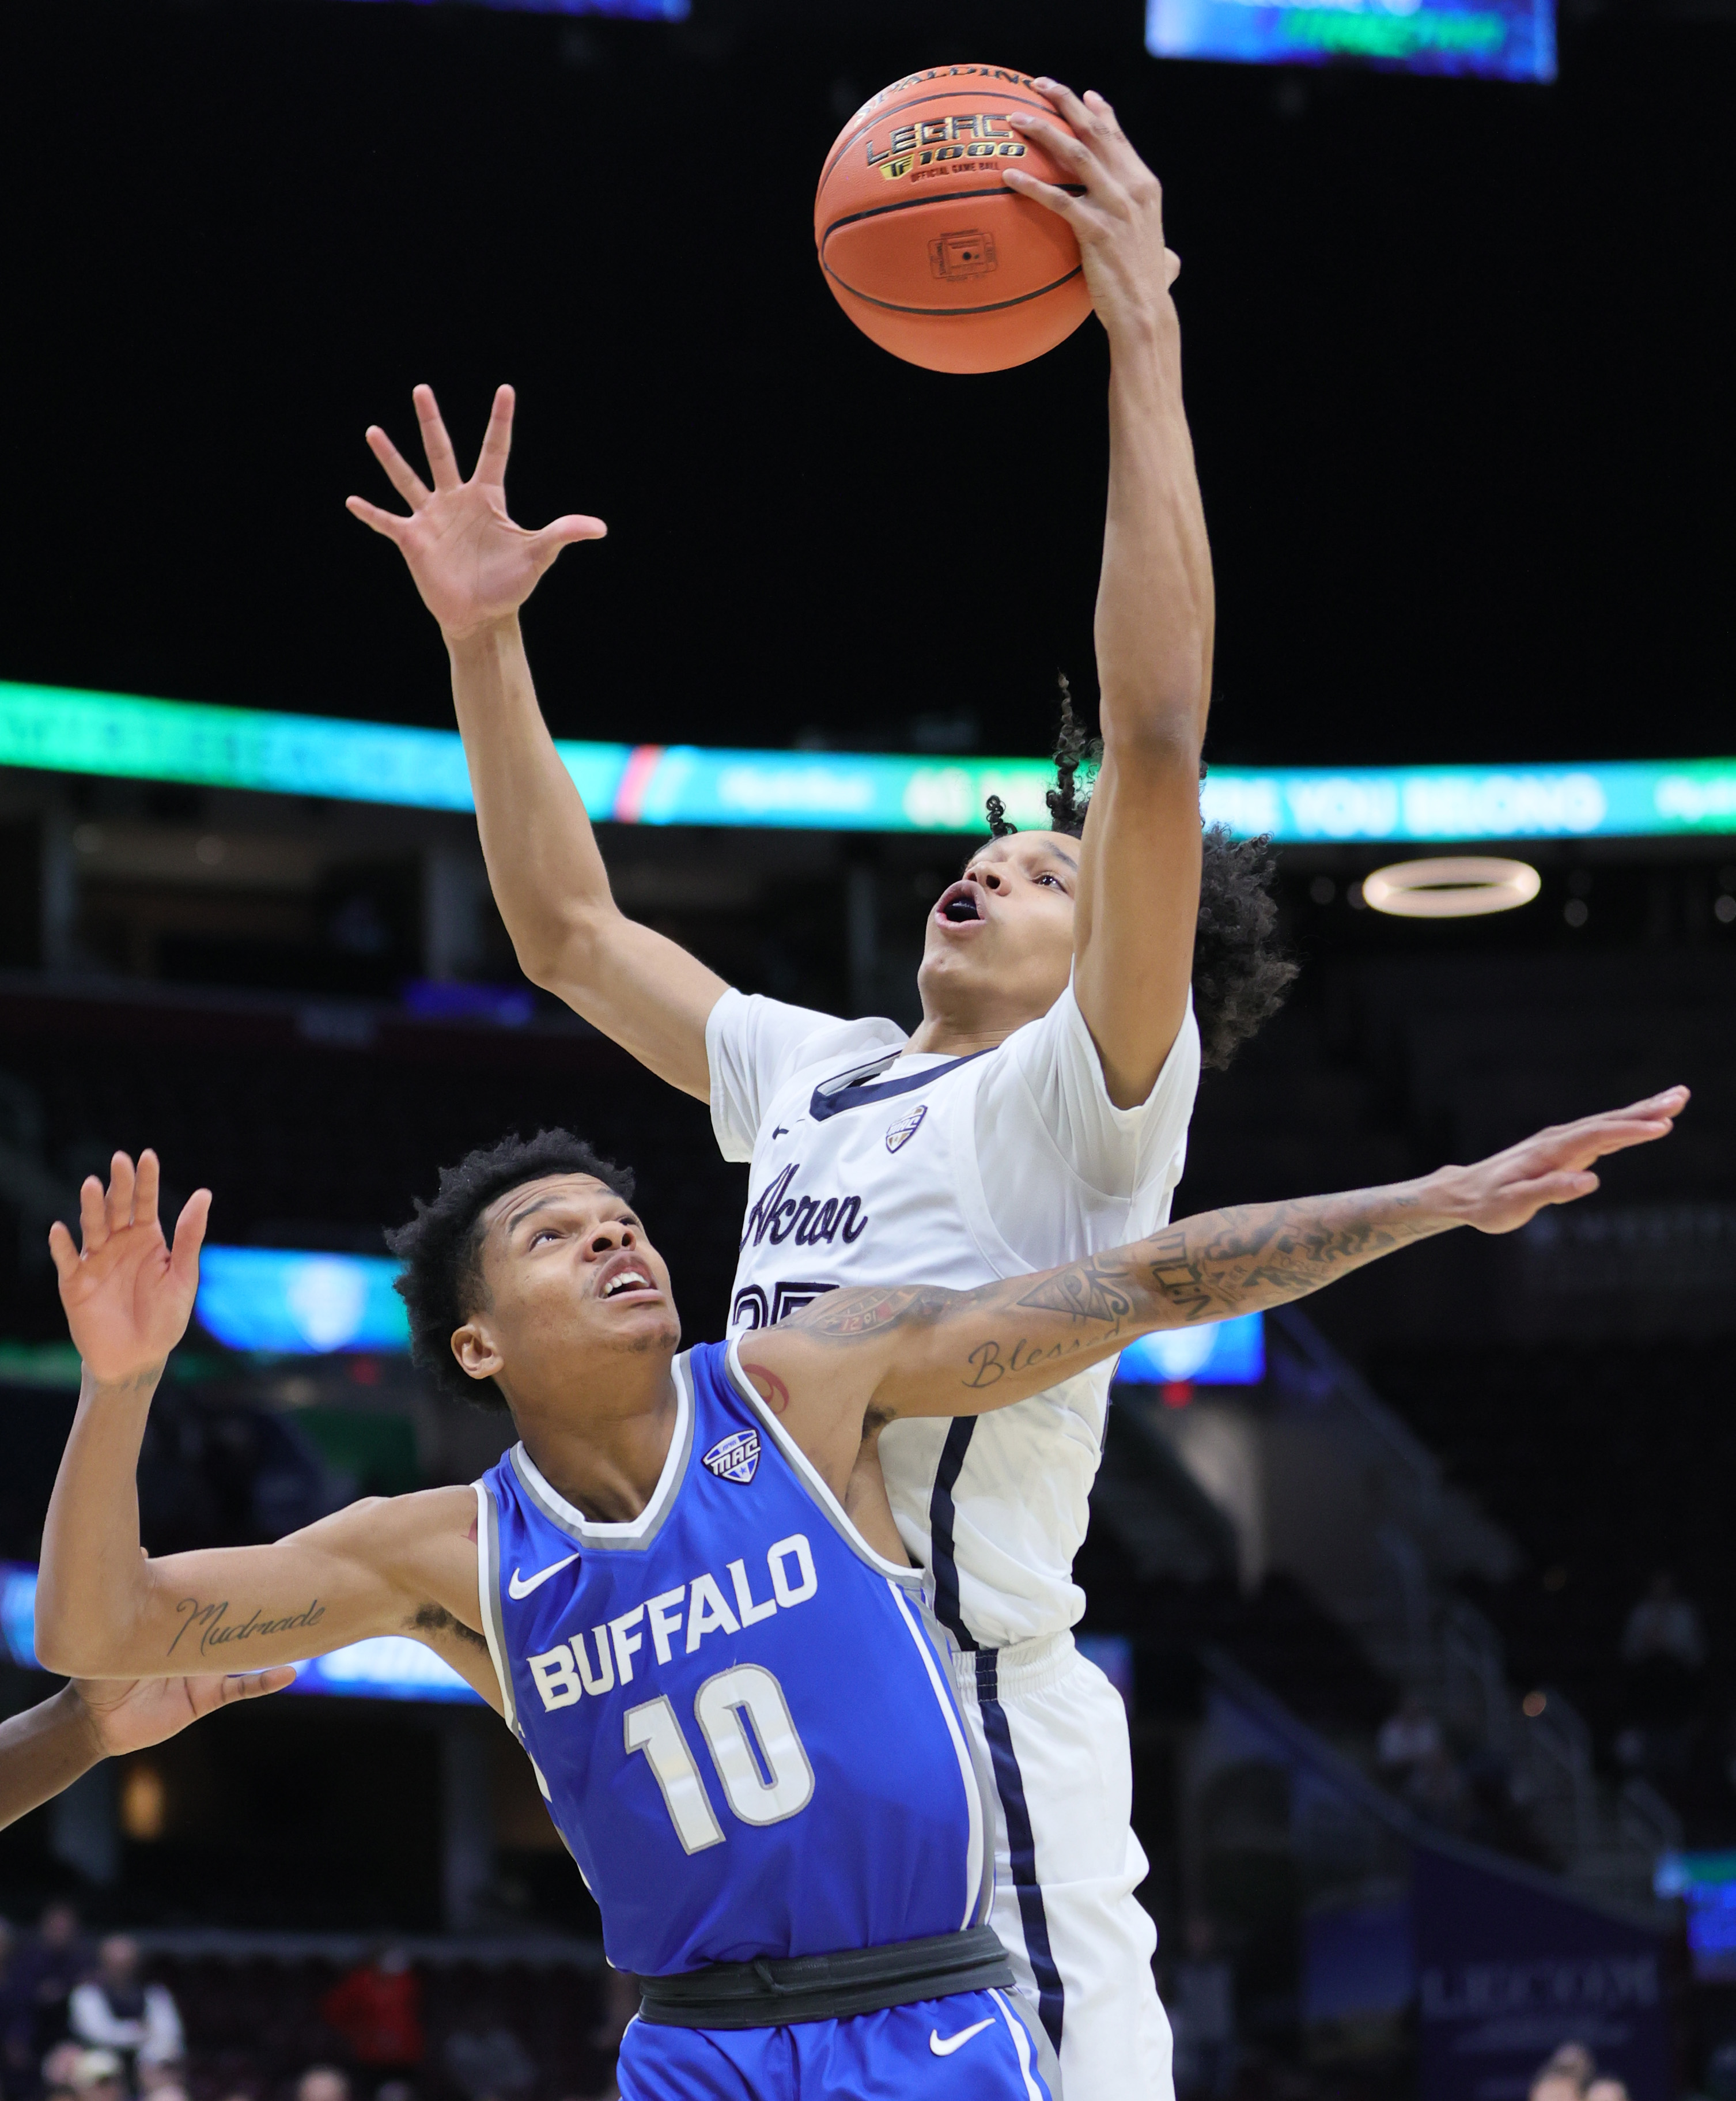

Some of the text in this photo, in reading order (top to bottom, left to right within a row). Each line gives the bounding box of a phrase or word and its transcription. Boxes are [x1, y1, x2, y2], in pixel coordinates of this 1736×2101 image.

[867, 114, 1013, 167] LEGAC
[920, 142, 1027, 165] 1000
[911, 161, 1001, 182] OFFICIAL GAME BALL
[739, 1162, 868, 1254] Akron
[710, 1438, 761, 1476] MAC
[526, 1533, 818, 1713] BUFFALO
[623, 1662, 816, 1856] 10
